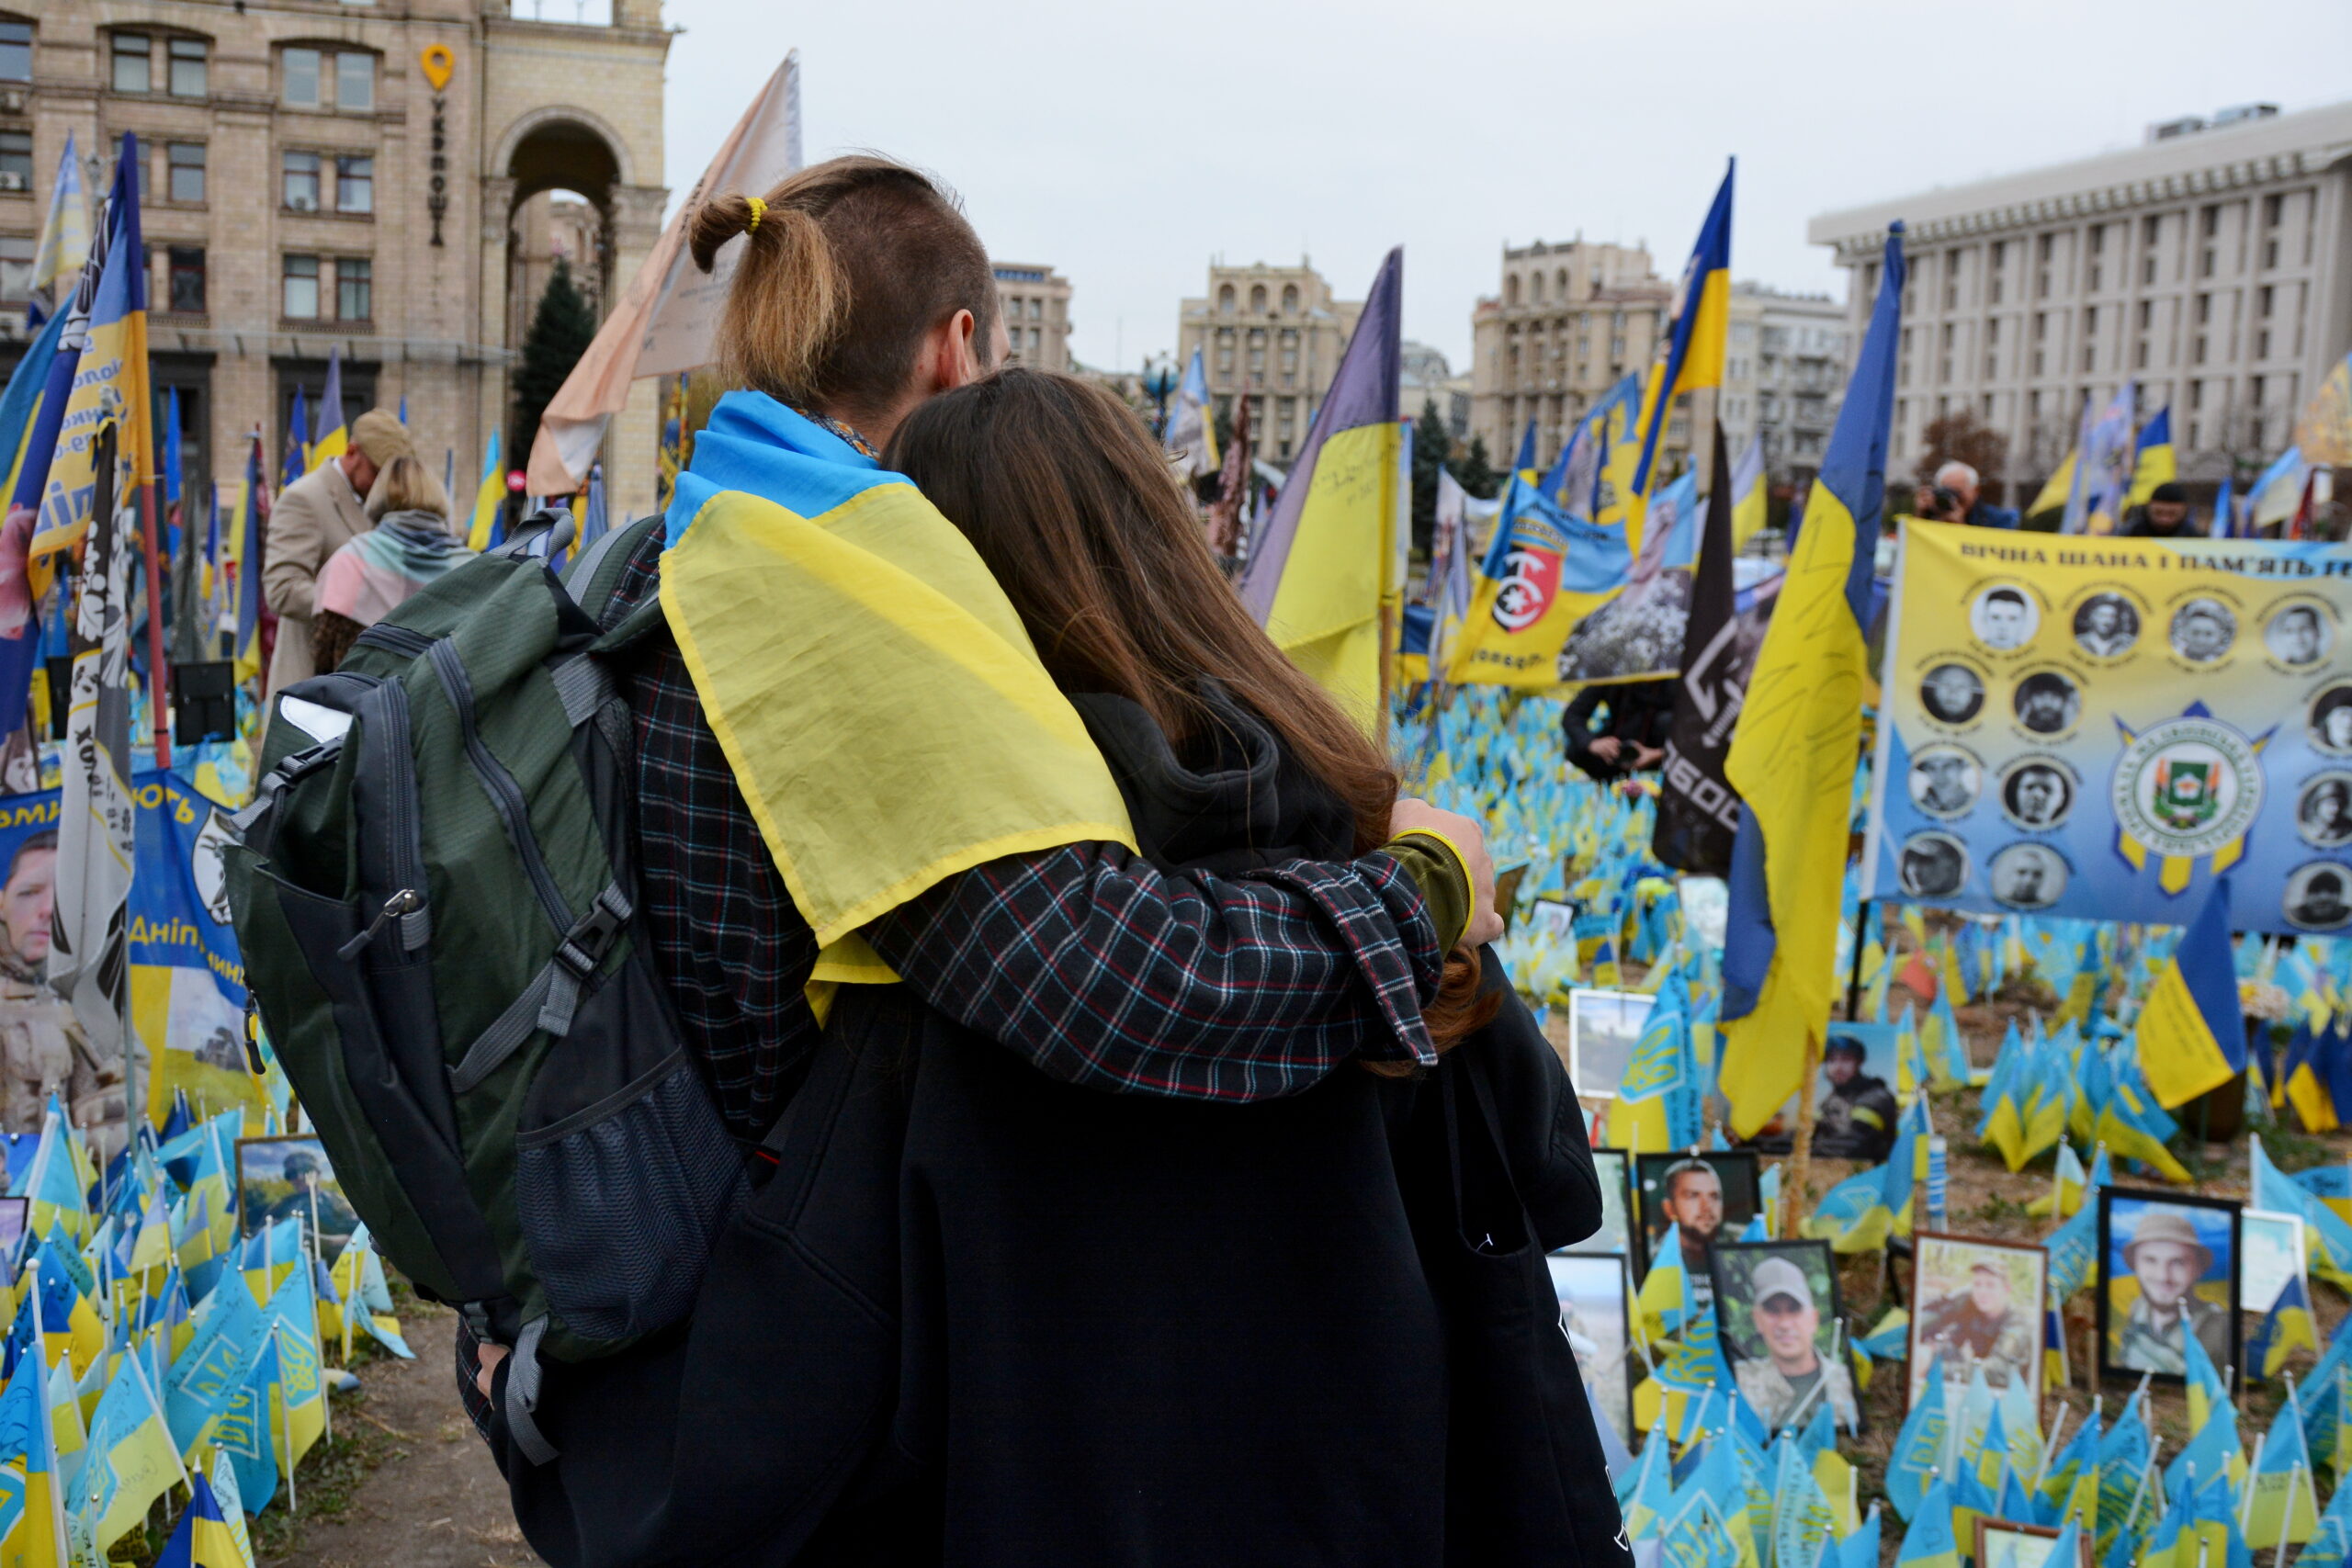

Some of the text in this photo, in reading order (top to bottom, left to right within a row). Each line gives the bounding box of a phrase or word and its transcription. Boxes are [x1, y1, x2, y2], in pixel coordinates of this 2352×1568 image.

[1960, 542, 2048, 566] ВІЧНА
[2058, 549, 2150, 570] ШАНА
[2160, 552, 2169, 570] І
[2178, 553, 2315, 577] ПАМ'ЯТЬ
